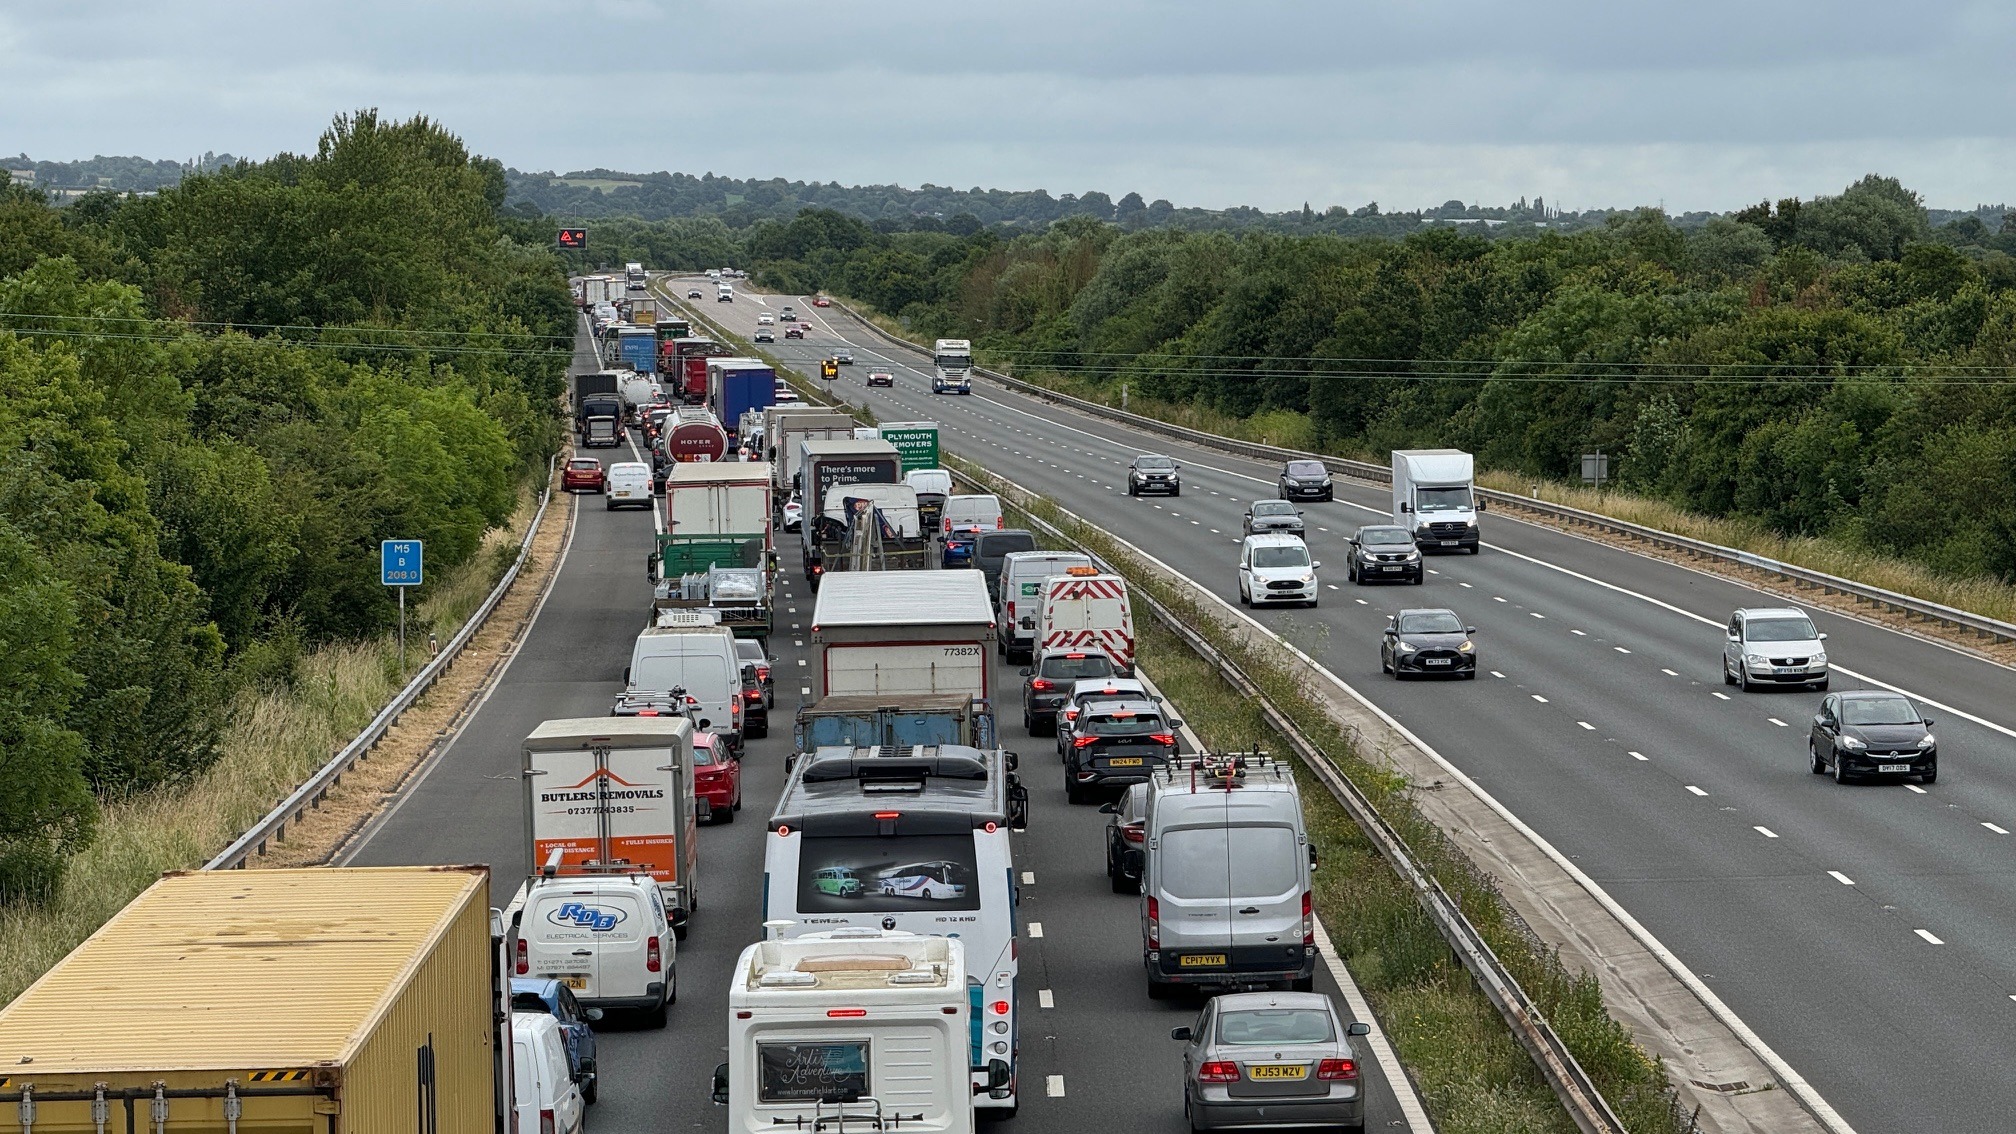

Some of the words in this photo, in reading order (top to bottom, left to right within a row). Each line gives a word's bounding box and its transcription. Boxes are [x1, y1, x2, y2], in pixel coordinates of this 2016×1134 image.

[394, 544, 410, 553] M5
[398, 557, 406, 567] B
[387, 571, 417, 579] 208.0
[943, 647, 980, 656] 77382X
[541, 792, 596, 802] BUTLERS
[599, 790, 664, 800] REMOVALS
[557, 902, 618, 932] RDB
[1185, 956, 1203, 964] CP17
[1255, 1067, 1280, 1077] RJ53
[1282, 1067, 1301, 1076] MZV
